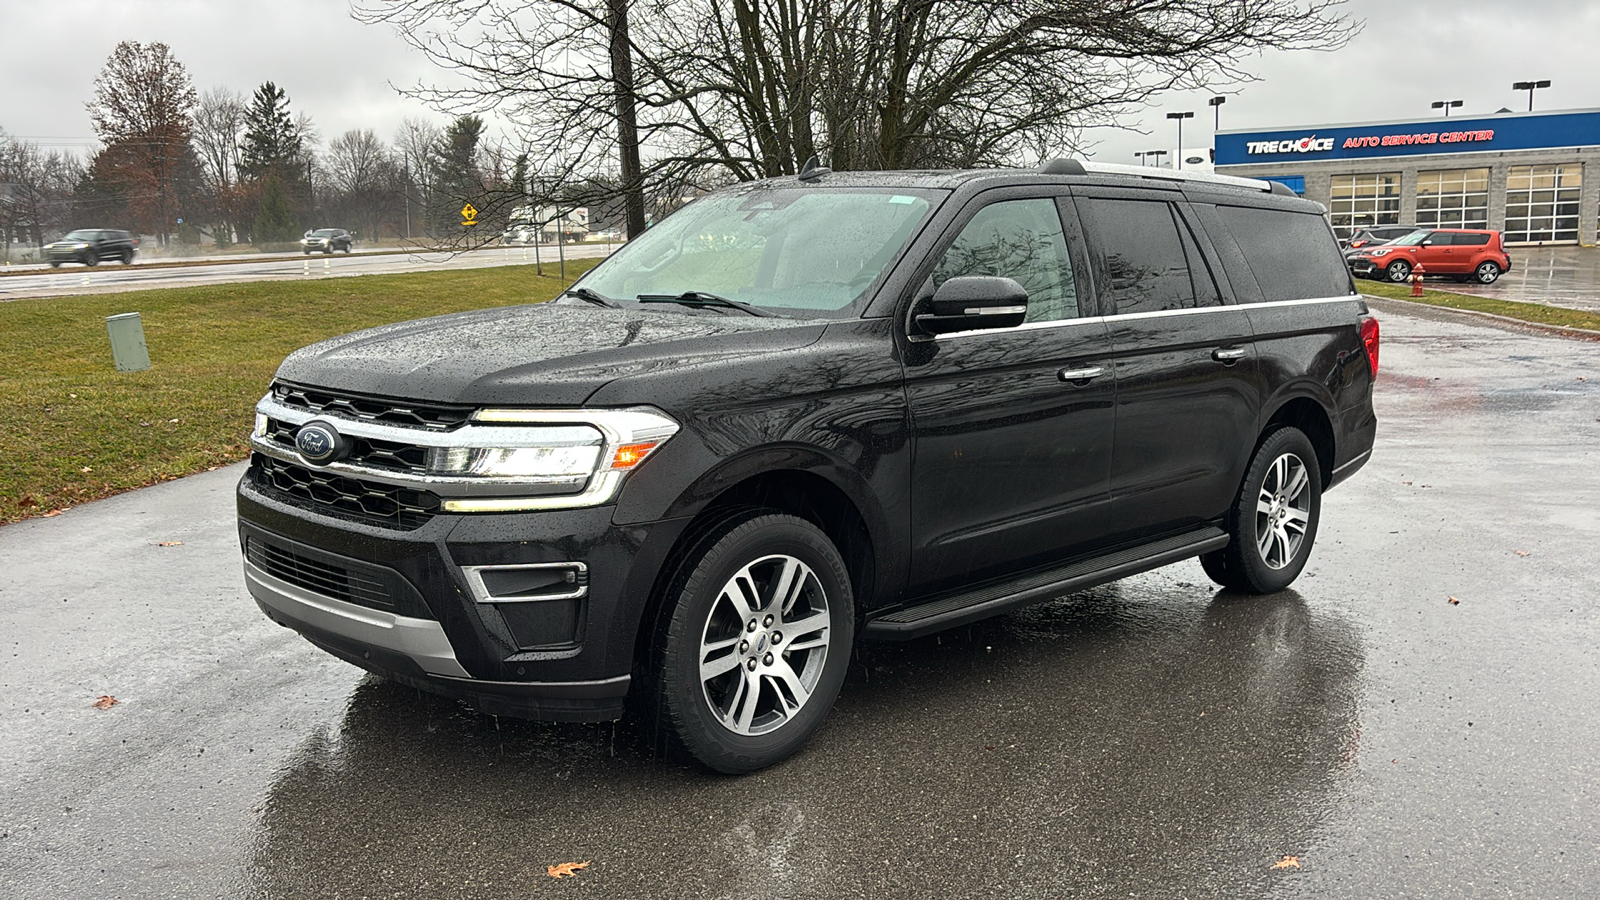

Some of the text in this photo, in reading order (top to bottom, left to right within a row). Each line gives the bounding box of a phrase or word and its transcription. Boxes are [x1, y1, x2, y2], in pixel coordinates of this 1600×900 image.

[1342, 129, 1494, 148] AUTO SERVICE CENTER
[301, 432, 323, 452] Ford
